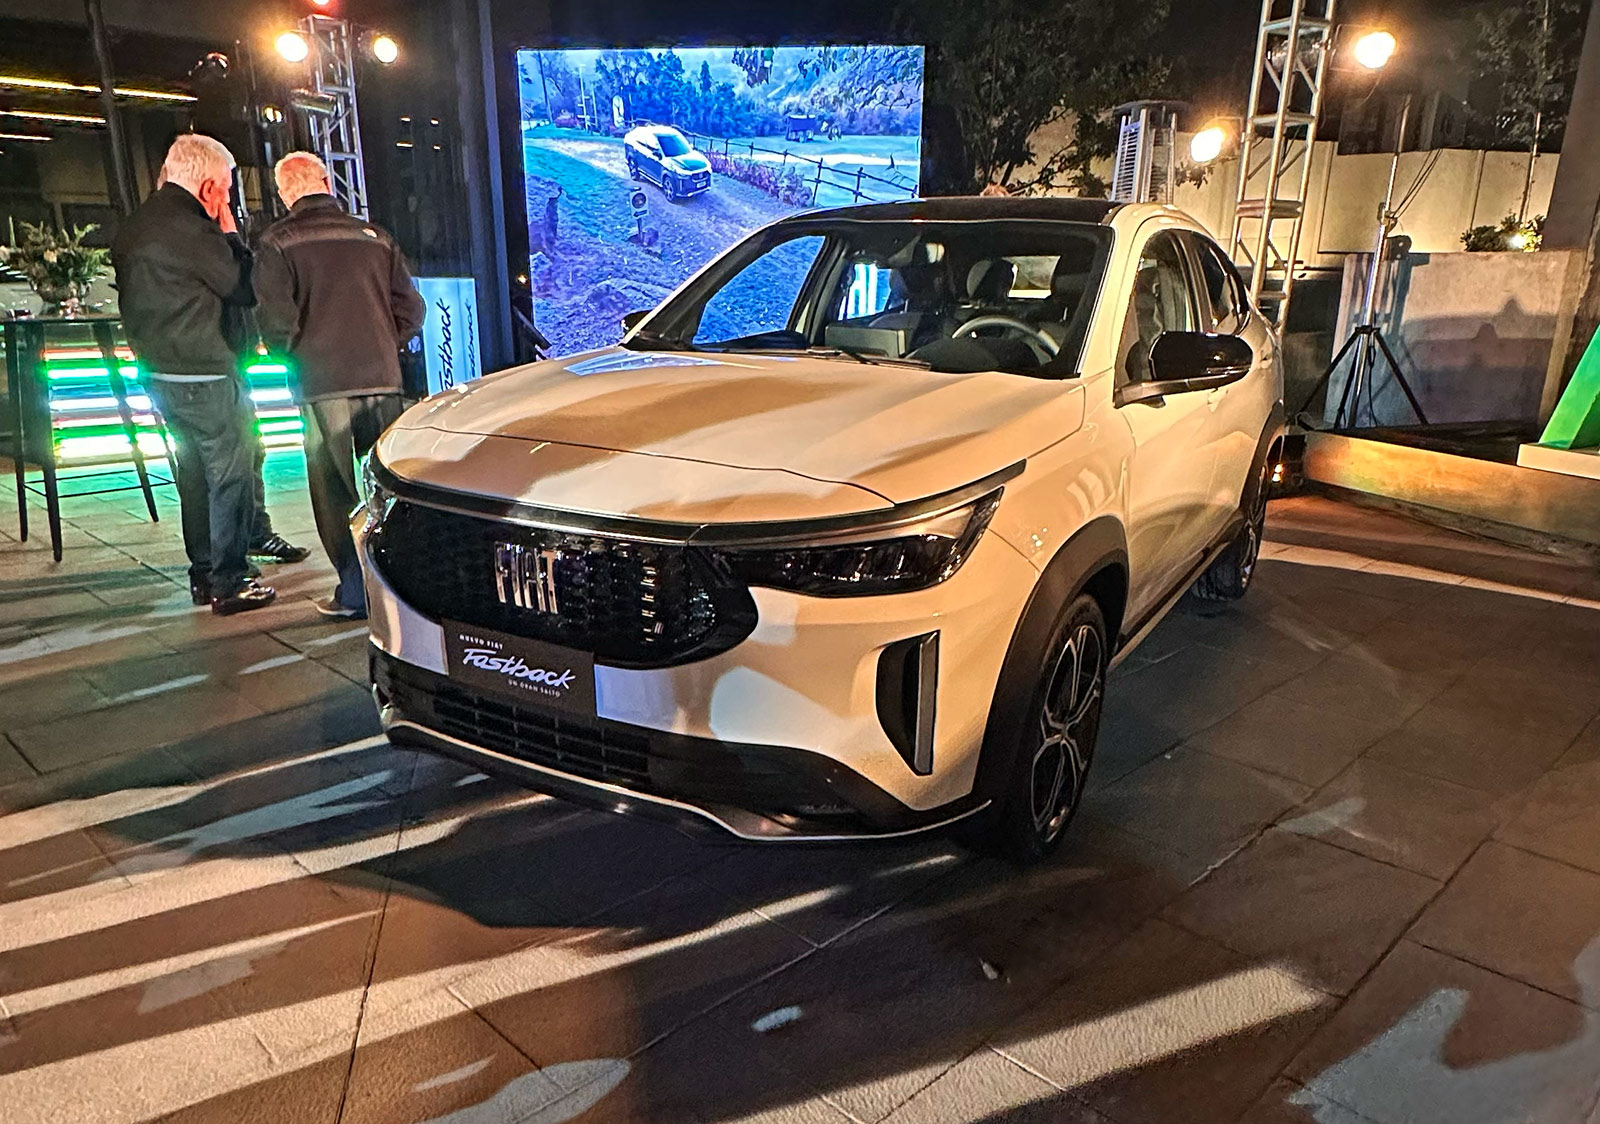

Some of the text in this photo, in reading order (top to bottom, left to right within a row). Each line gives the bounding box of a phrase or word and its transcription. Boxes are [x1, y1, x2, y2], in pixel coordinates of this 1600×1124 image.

[494, 541, 563, 615] FIAT
[459, 634, 503, 650] NUEVO FIAT
[462, 648, 576, 690] Fastback
[508, 678, 561, 698] UN GRAN SALTO
